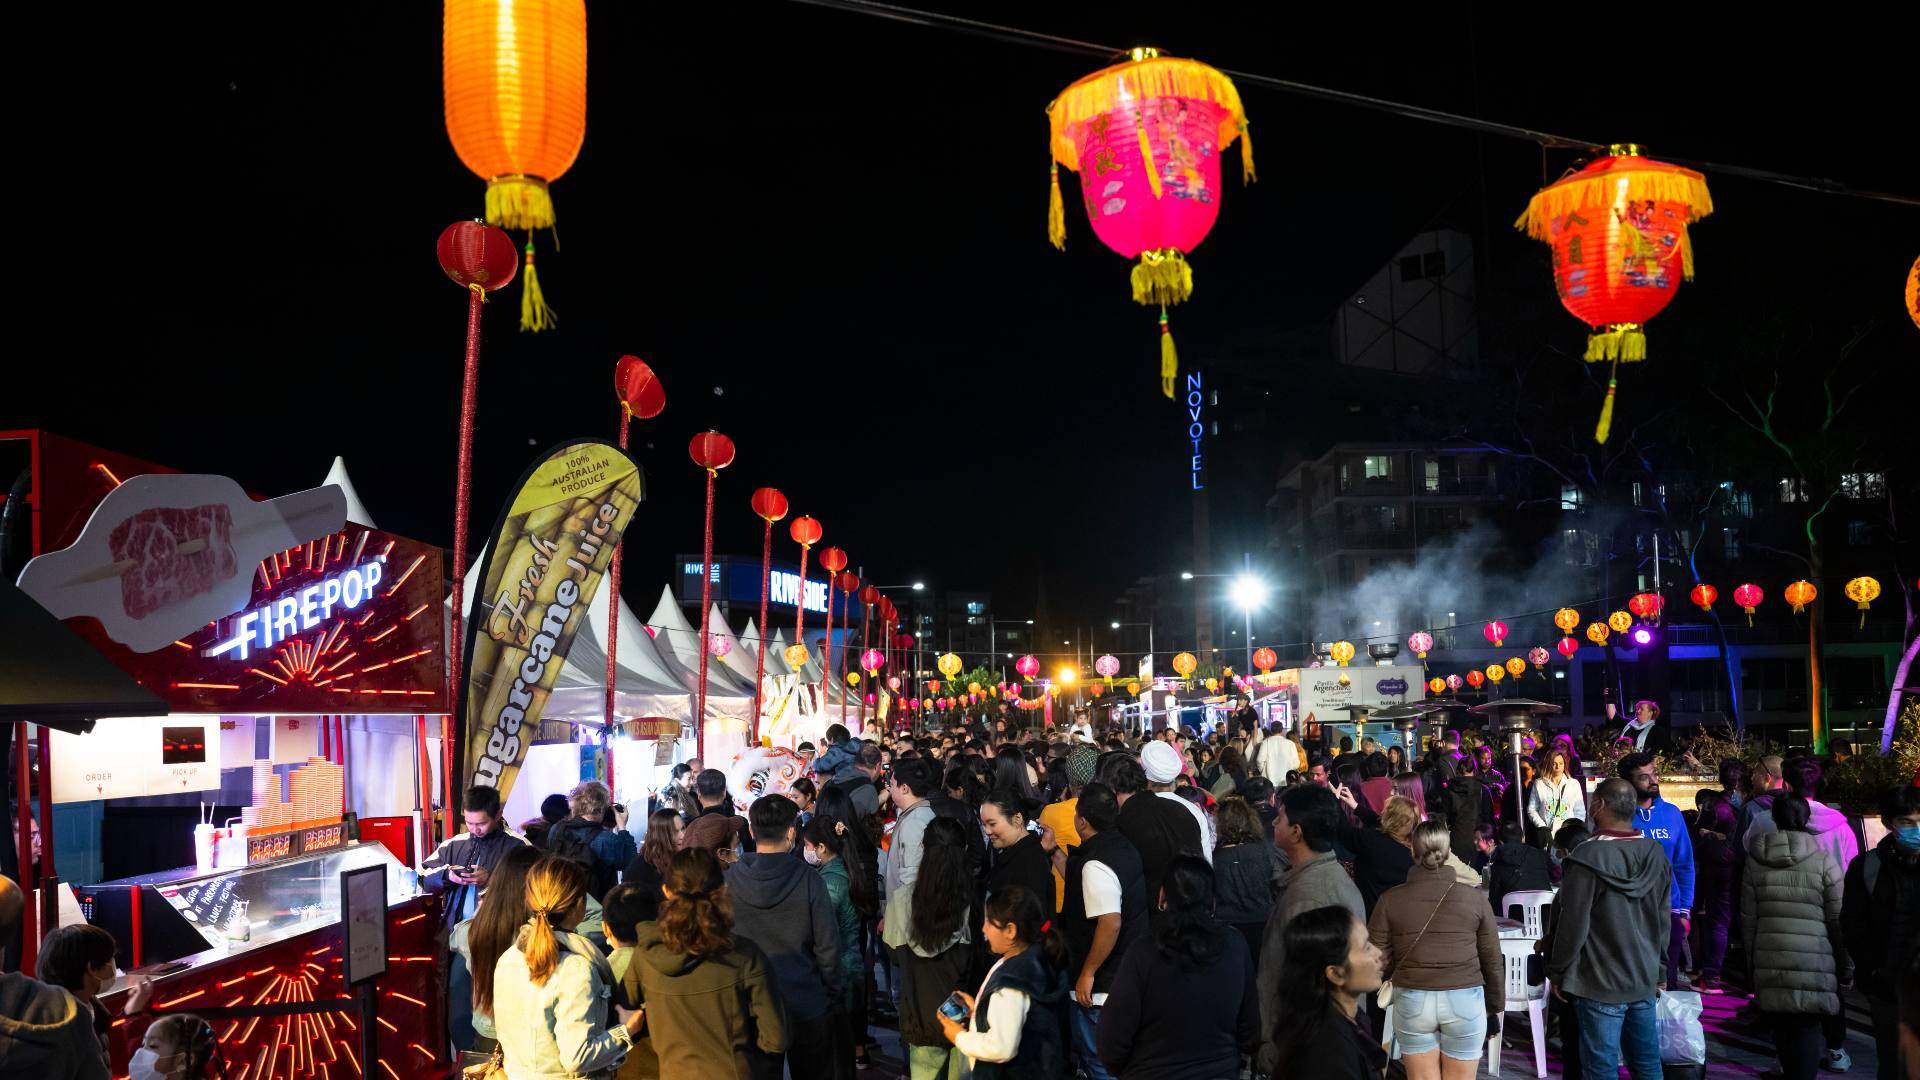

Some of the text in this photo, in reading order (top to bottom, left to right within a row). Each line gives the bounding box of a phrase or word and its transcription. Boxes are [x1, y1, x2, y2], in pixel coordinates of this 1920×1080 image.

[1187, 371, 1204, 491] NOVOTEL
[552, 458, 610, 487] AUSTRALIAN
[565, 454, 590, 470] 100%
[561, 472, 606, 496] PRODUCE
[487, 533, 560, 645] Fresh
[203, 560, 382, 661] FIREPOP
[472, 502, 619, 788] ugarcane Juice
[85, 772, 112, 782] ORDER
[172, 768, 188, 777] PICK
[1650, 828, 1671, 840] YES.
